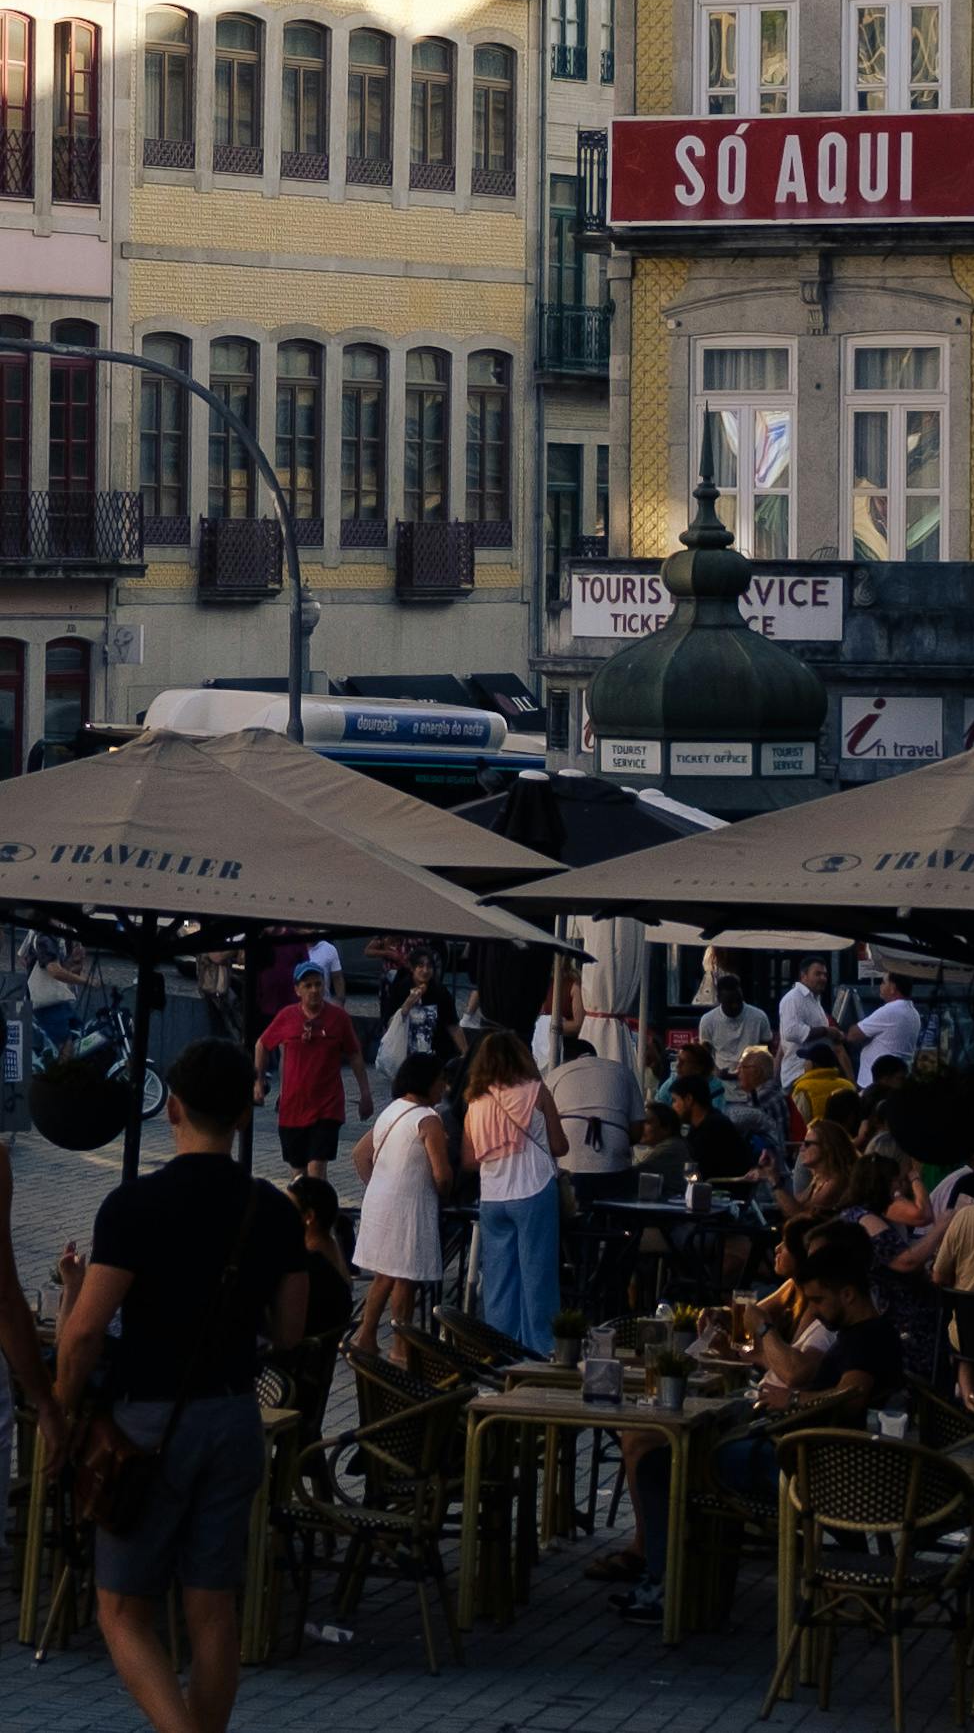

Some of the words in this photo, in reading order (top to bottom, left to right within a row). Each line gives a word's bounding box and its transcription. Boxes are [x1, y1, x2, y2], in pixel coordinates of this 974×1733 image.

[674, 123, 750, 207] SÓ
[774, 131, 913, 205] AQUI
[578, 576, 677, 604] TOURIS
[739, 579, 830, 607] VICE
[610, 613, 667, 634] TICKE
[611, 744, 647, 755] TOURIST
[771, 747, 805, 757] TOURIST
[893, 741, 941, 758] travel
[612, 757, 647, 769] SERVICE
[676, 754, 711, 764] TICKET
[713, 752, 748, 764] OFFICE
[772, 759, 804, 771] SERVICE
[51, 843, 243, 880] TRAVELLER
